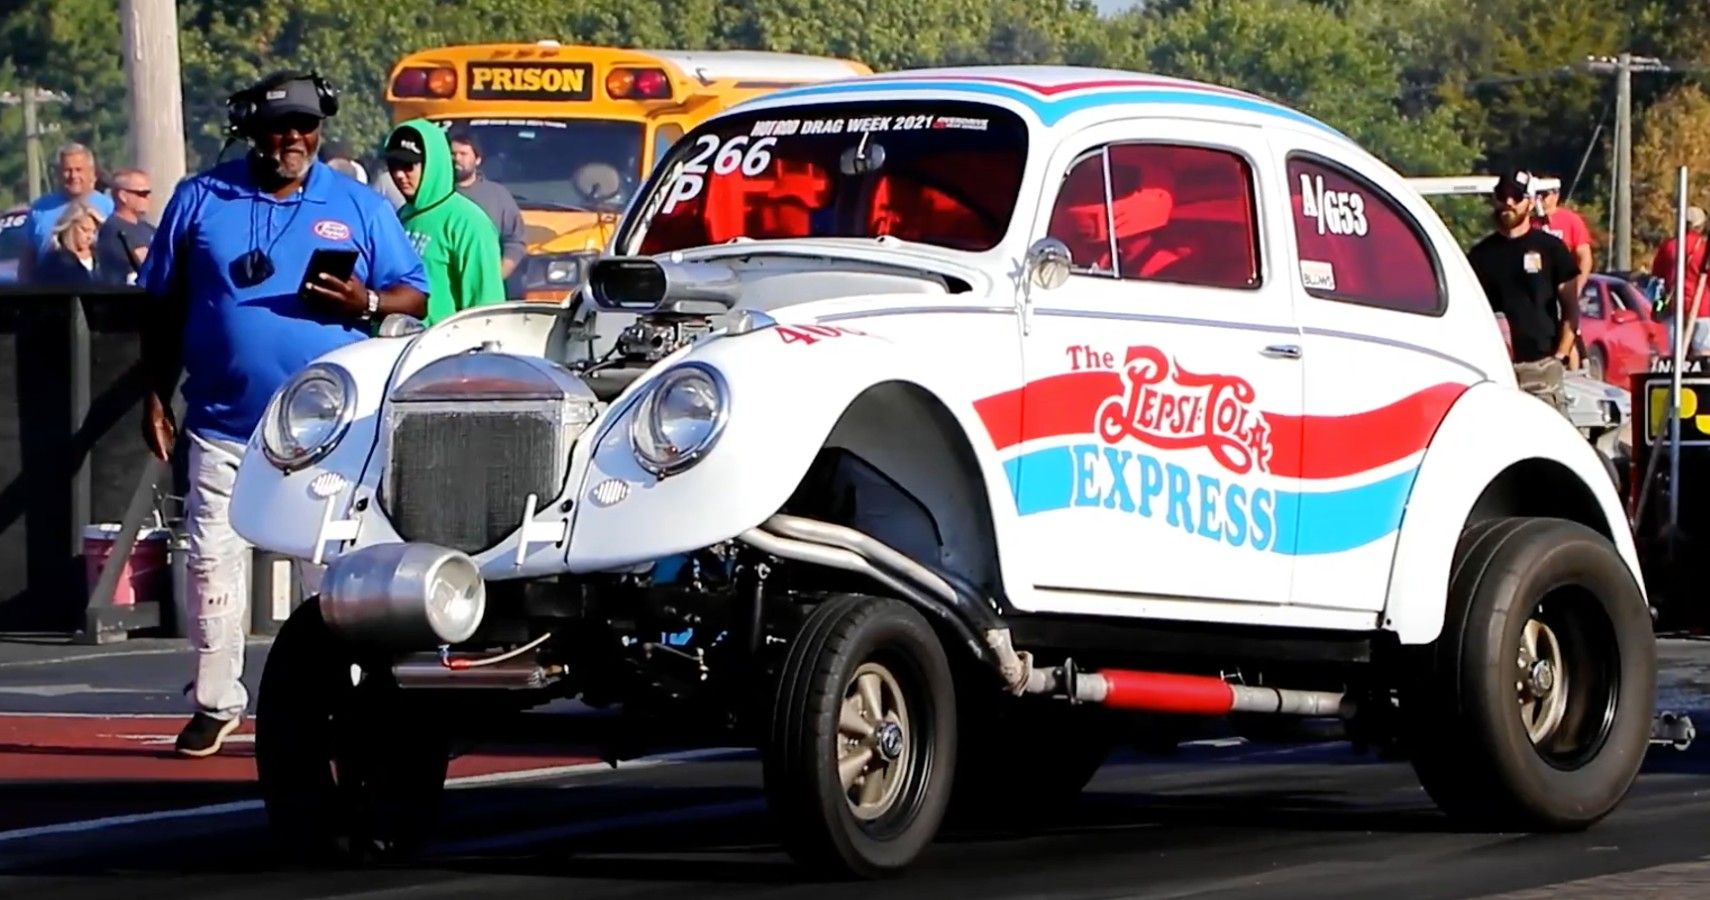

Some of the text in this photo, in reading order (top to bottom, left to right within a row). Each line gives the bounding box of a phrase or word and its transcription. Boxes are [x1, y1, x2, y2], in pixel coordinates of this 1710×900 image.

[472, 67, 585, 92] PRISON
[800, 119, 845, 134] DRAG
[846, 116, 893, 133] WEEK
[892, 114, 934, 131] 2021
[681, 134, 778, 177] 266
[662, 174, 704, 214] P
[1300, 173, 1369, 237] A/G53
[1066, 344, 1115, 370] The
[1073, 444, 1273, 551] EXPRESS
